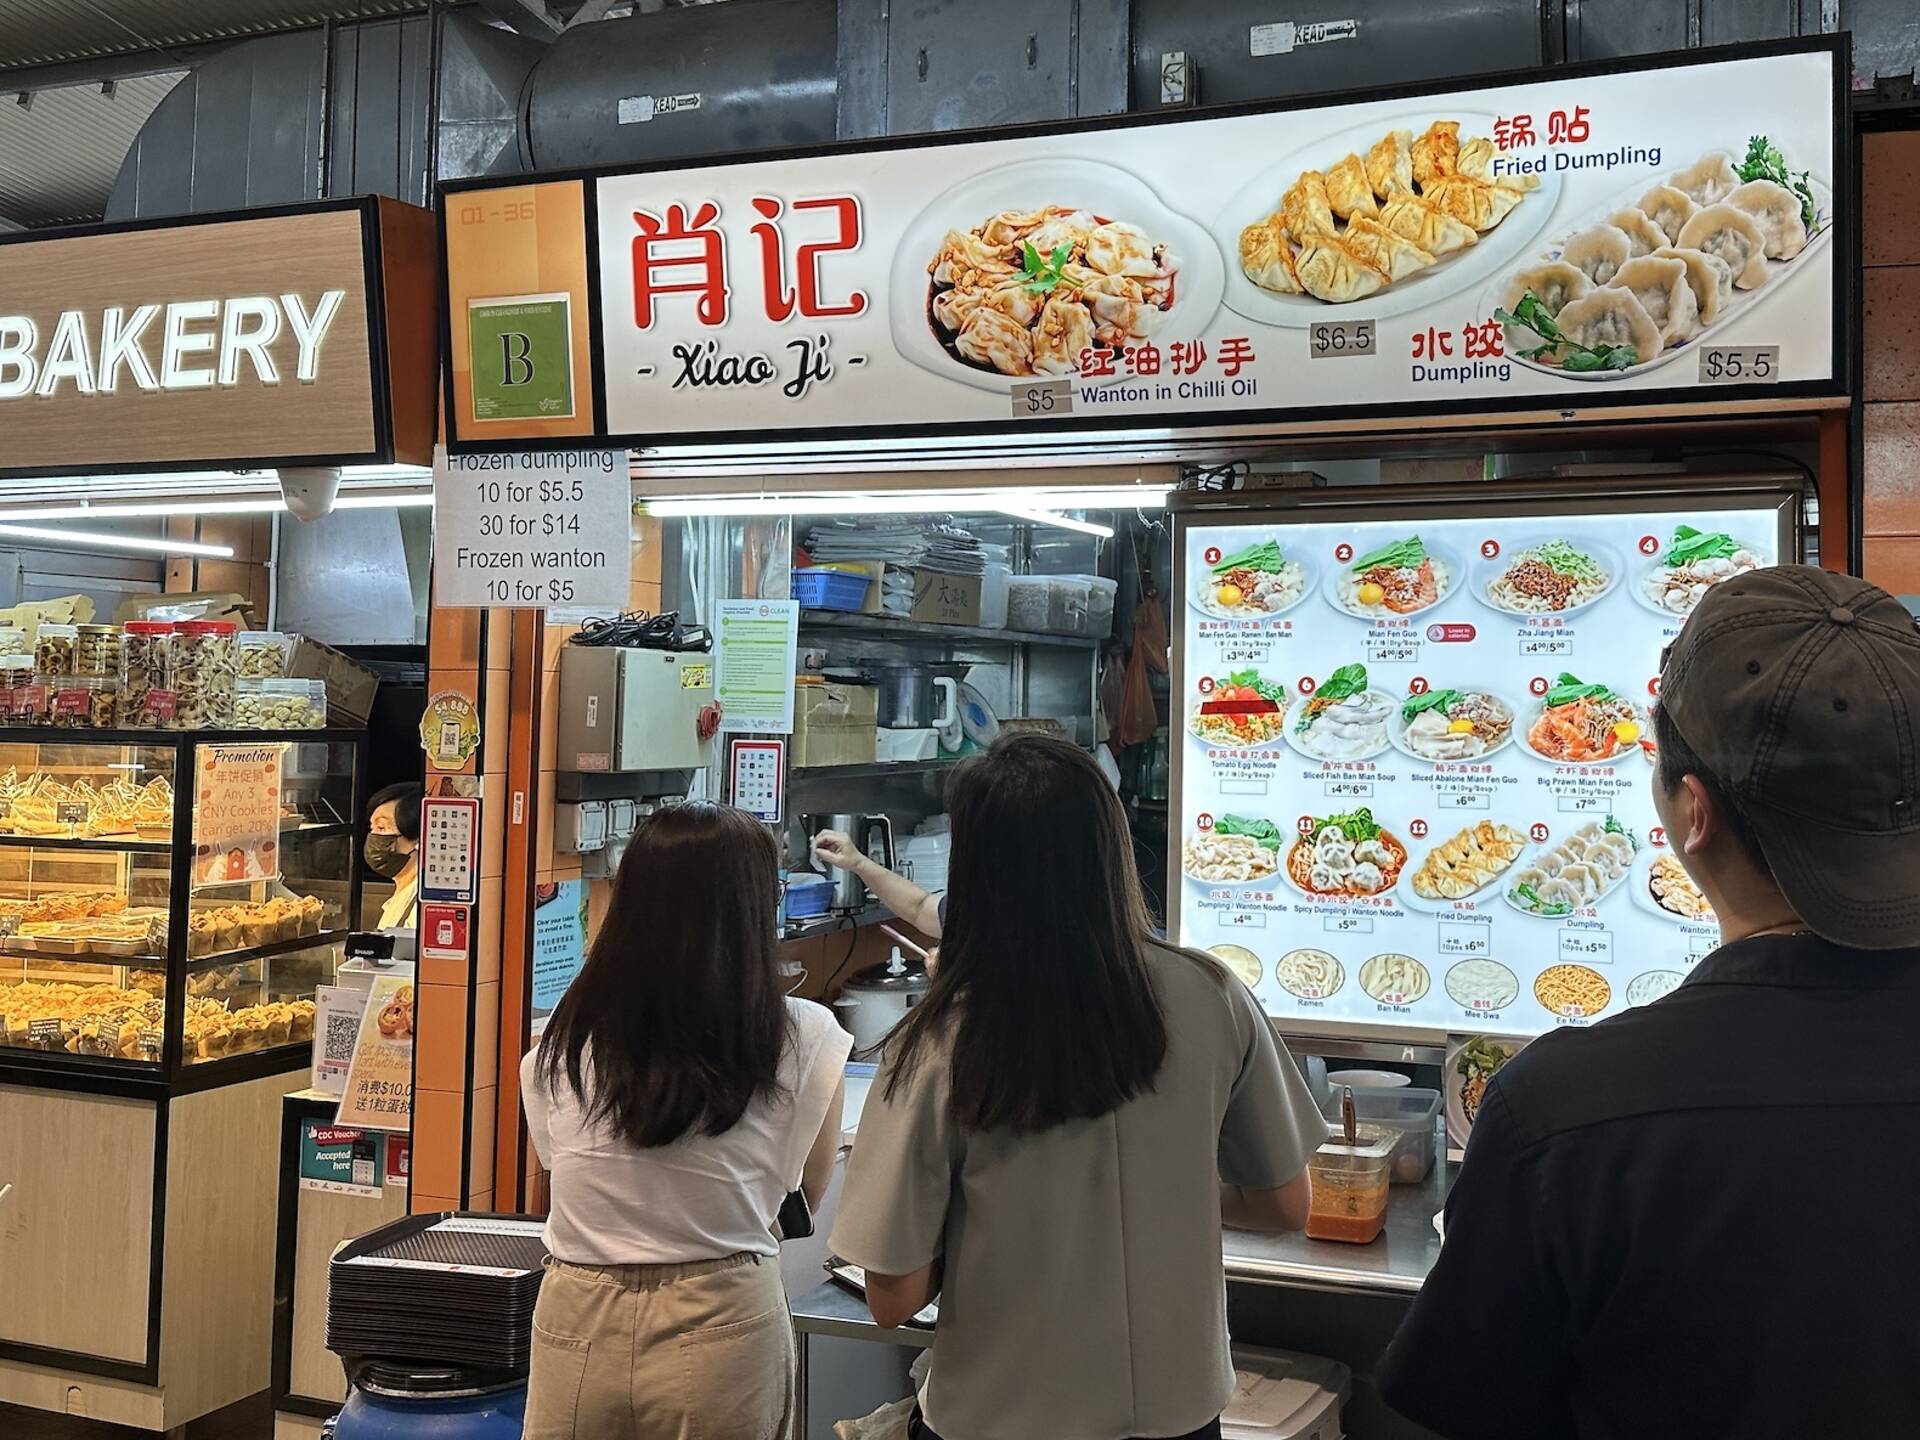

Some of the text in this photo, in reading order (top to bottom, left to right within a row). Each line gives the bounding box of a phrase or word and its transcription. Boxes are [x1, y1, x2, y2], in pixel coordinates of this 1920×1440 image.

[1295, 25, 1325, 43] KEAD
[654, 97, 676, 113] KEAD
[1493, 105, 1590, 151] 锅贴
[1493, 146, 1662, 176] Fried Dumpling
[632, 197, 865, 328] 肖记
[0, 290, 345, 398] BAKERY
[1315, 326, 1370, 352] $6.5
[1411, 318, 1504, 360] 水饺
[499, 331, 535, 387] B
[672, 335, 830, 397] Xiao Ji
[1079, 337, 1255, 378] 红油抄手
[1706, 352, 1770, 379] $5.5
[1411, 362, 1511, 382] Dumpling
[1081, 378, 1257, 403] Wanton in Chilli Oil
[1027, 389, 1055, 413] $5
[447, 450, 613, 473] Frozen dumpling
[478, 480, 583, 504] 10 for $5.5
[479, 513, 580, 537] 30 for $14
[457, 547, 605, 568] Frozen wanton
[487, 578, 574, 603] 10 for $5
[1534, 629, 1554, 638] Jiang
[213, 748, 274, 764] Promotion
[1211, 760, 1236, 768] Tomato
[1238, 761, 1250, 769] Egg
[1303, 771, 1324, 779] Sliced
[1537, 778, 1550, 786] Big
[1615, 779, 1632, 787] Guo
[224, 786, 255, 801] Any 3
[202, 804, 273, 818] CNY Cookies
[202, 820, 273, 838] can get 20%
[1198, 900, 1230, 910] Dumpling
[1294, 905, 1404, 917] Spicy Dumpling Wanton Noodle
[1436, 912, 1492, 923] Fried Dumpling
[1567, 919, 1604, 930] Dumpling
[1680, 925, 1710, 934] Wanton
[1298, 999, 1324, 1007] Ramen
[1377, 1004, 1411, 1013] Ban Mian
[1465, 1010, 1499, 1019] Mee Swa
[318, 1131, 333, 1140] CDC
[316, 1150, 351, 1161] Accepted
[333, 1162, 351, 1170] here
